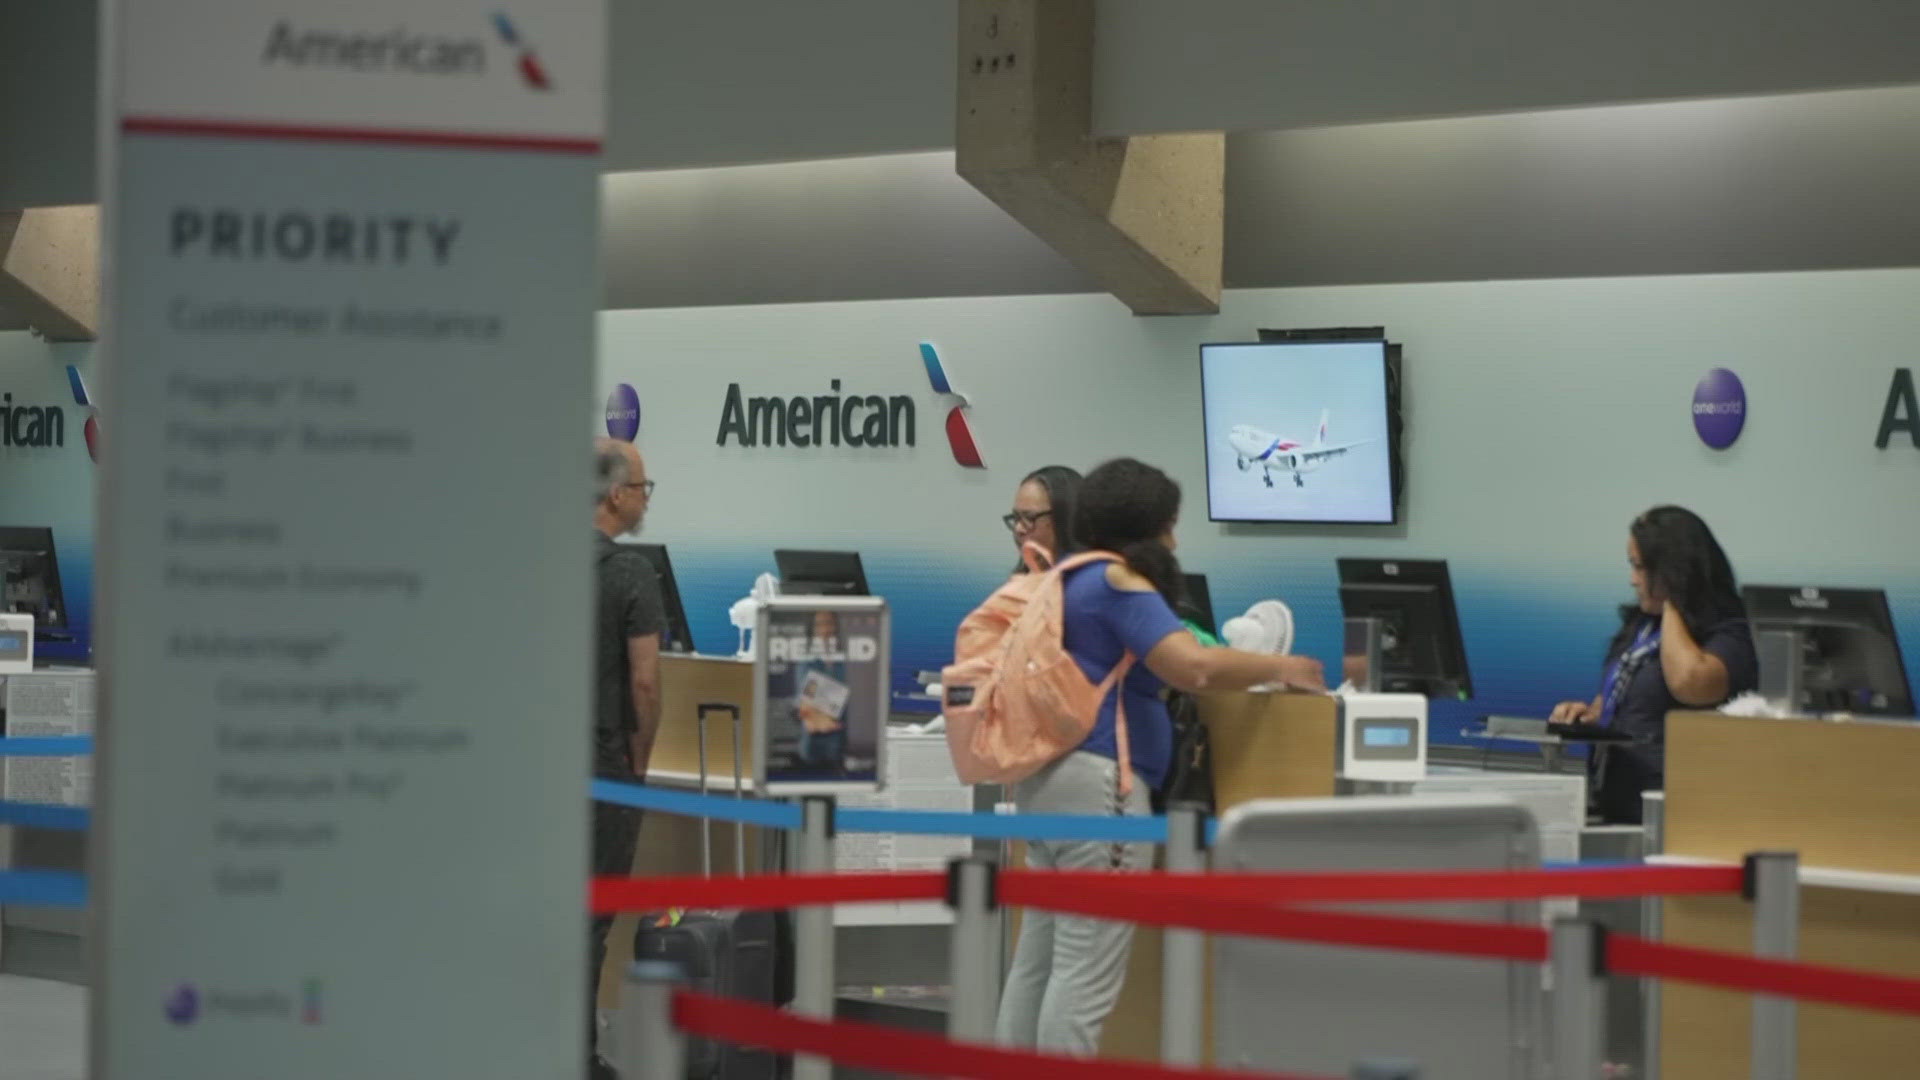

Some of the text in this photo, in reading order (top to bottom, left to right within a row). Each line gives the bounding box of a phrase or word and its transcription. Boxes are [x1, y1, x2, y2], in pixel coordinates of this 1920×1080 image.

[263, 20, 484, 73] American
[170, 208, 460, 264] PRIORITY
[0, 392, 64, 447] ican
[716, 379, 916, 447] American
[769, 636, 878, 662] REAL ID
